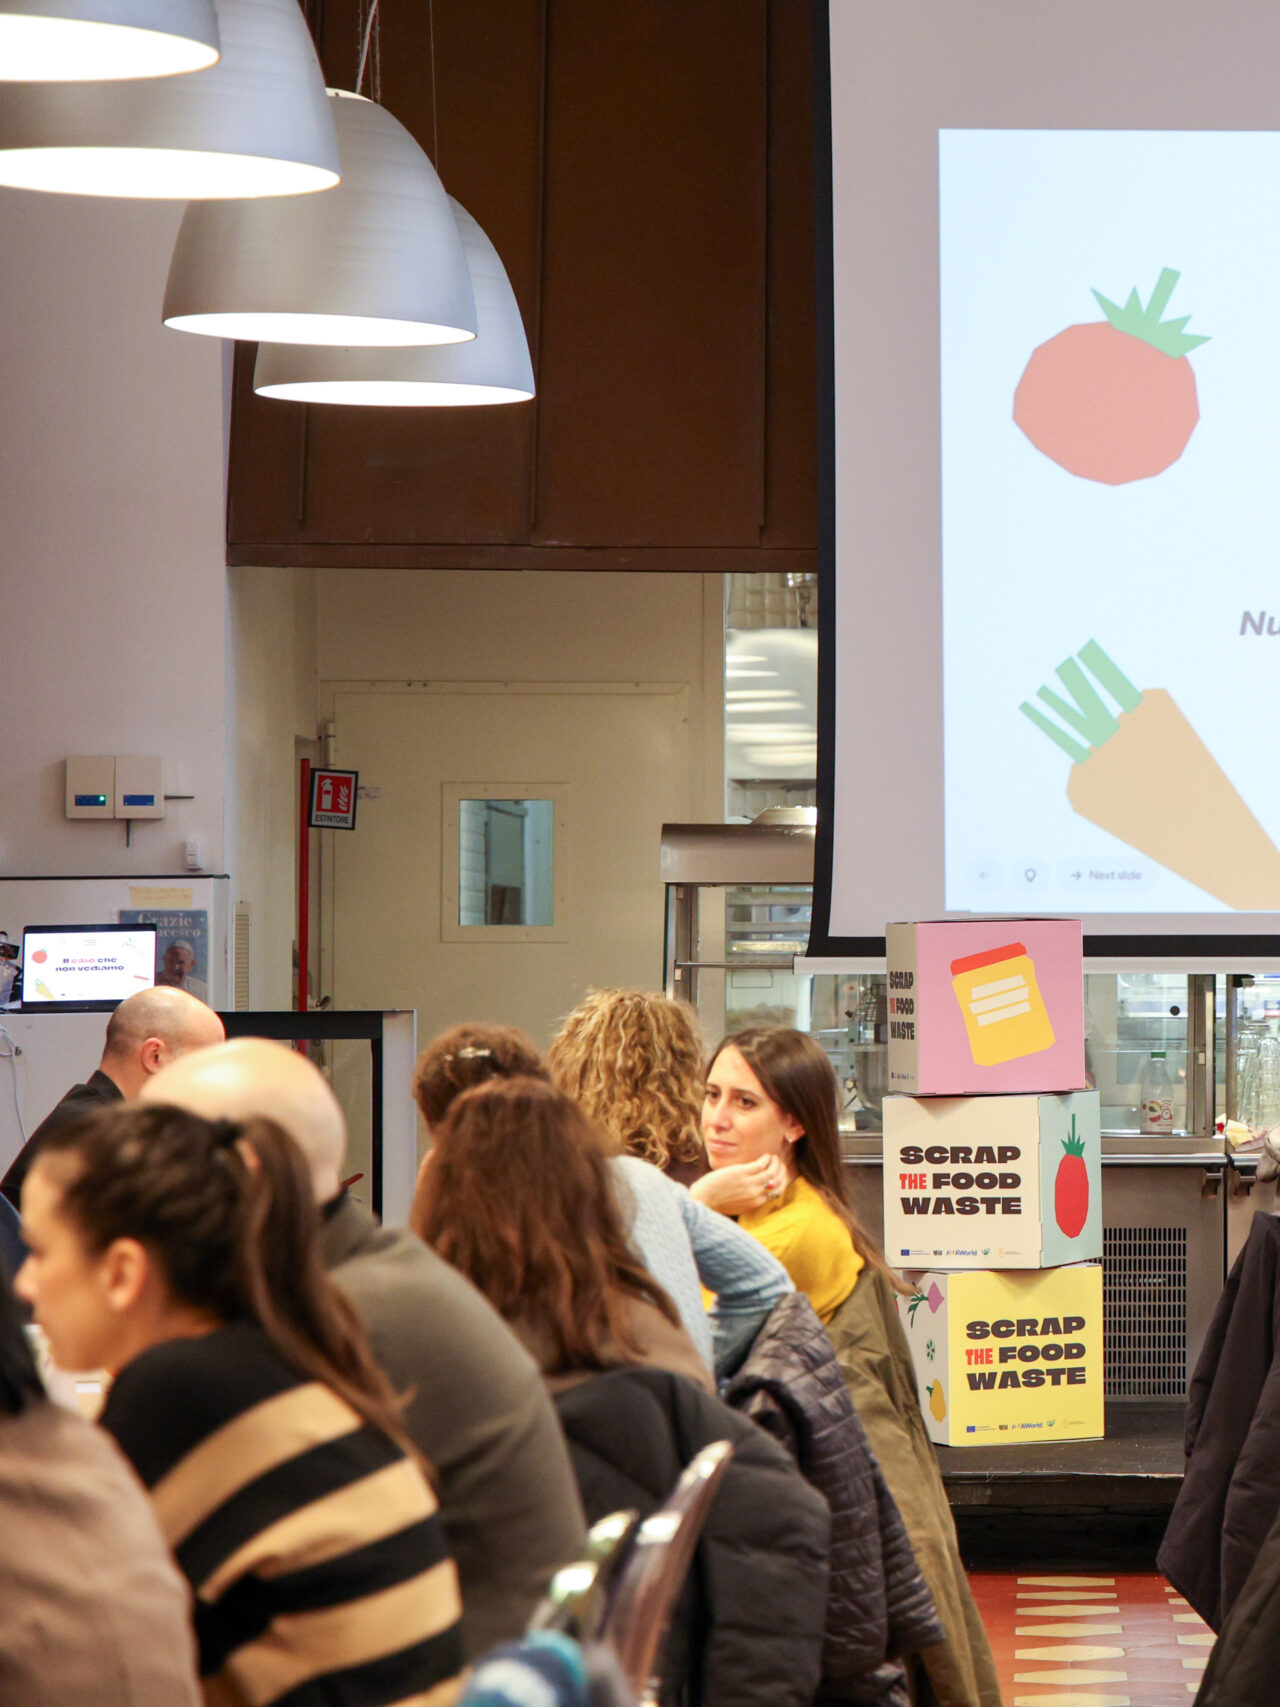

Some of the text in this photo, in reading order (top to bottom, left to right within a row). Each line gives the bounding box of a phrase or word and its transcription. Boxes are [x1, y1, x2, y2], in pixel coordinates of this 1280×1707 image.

[315, 814, 350, 824] ESTINTORE
[1089, 870, 1142, 881] Next slide
[889, 970, 914, 990] SCRAP
[896, 997, 915, 1015] FOOD
[890, 1021, 915, 1041] WASTE
[899, 1145, 1022, 1165] SCRAP
[899, 1172, 1022, 1190] THE FOOD
[900, 1196, 1022, 1216] WASTE
[965, 1315, 1086, 1340] SCRAP
[965, 1342, 1086, 1366] THE FOOD
[966, 1366, 1086, 1392] WASTE
